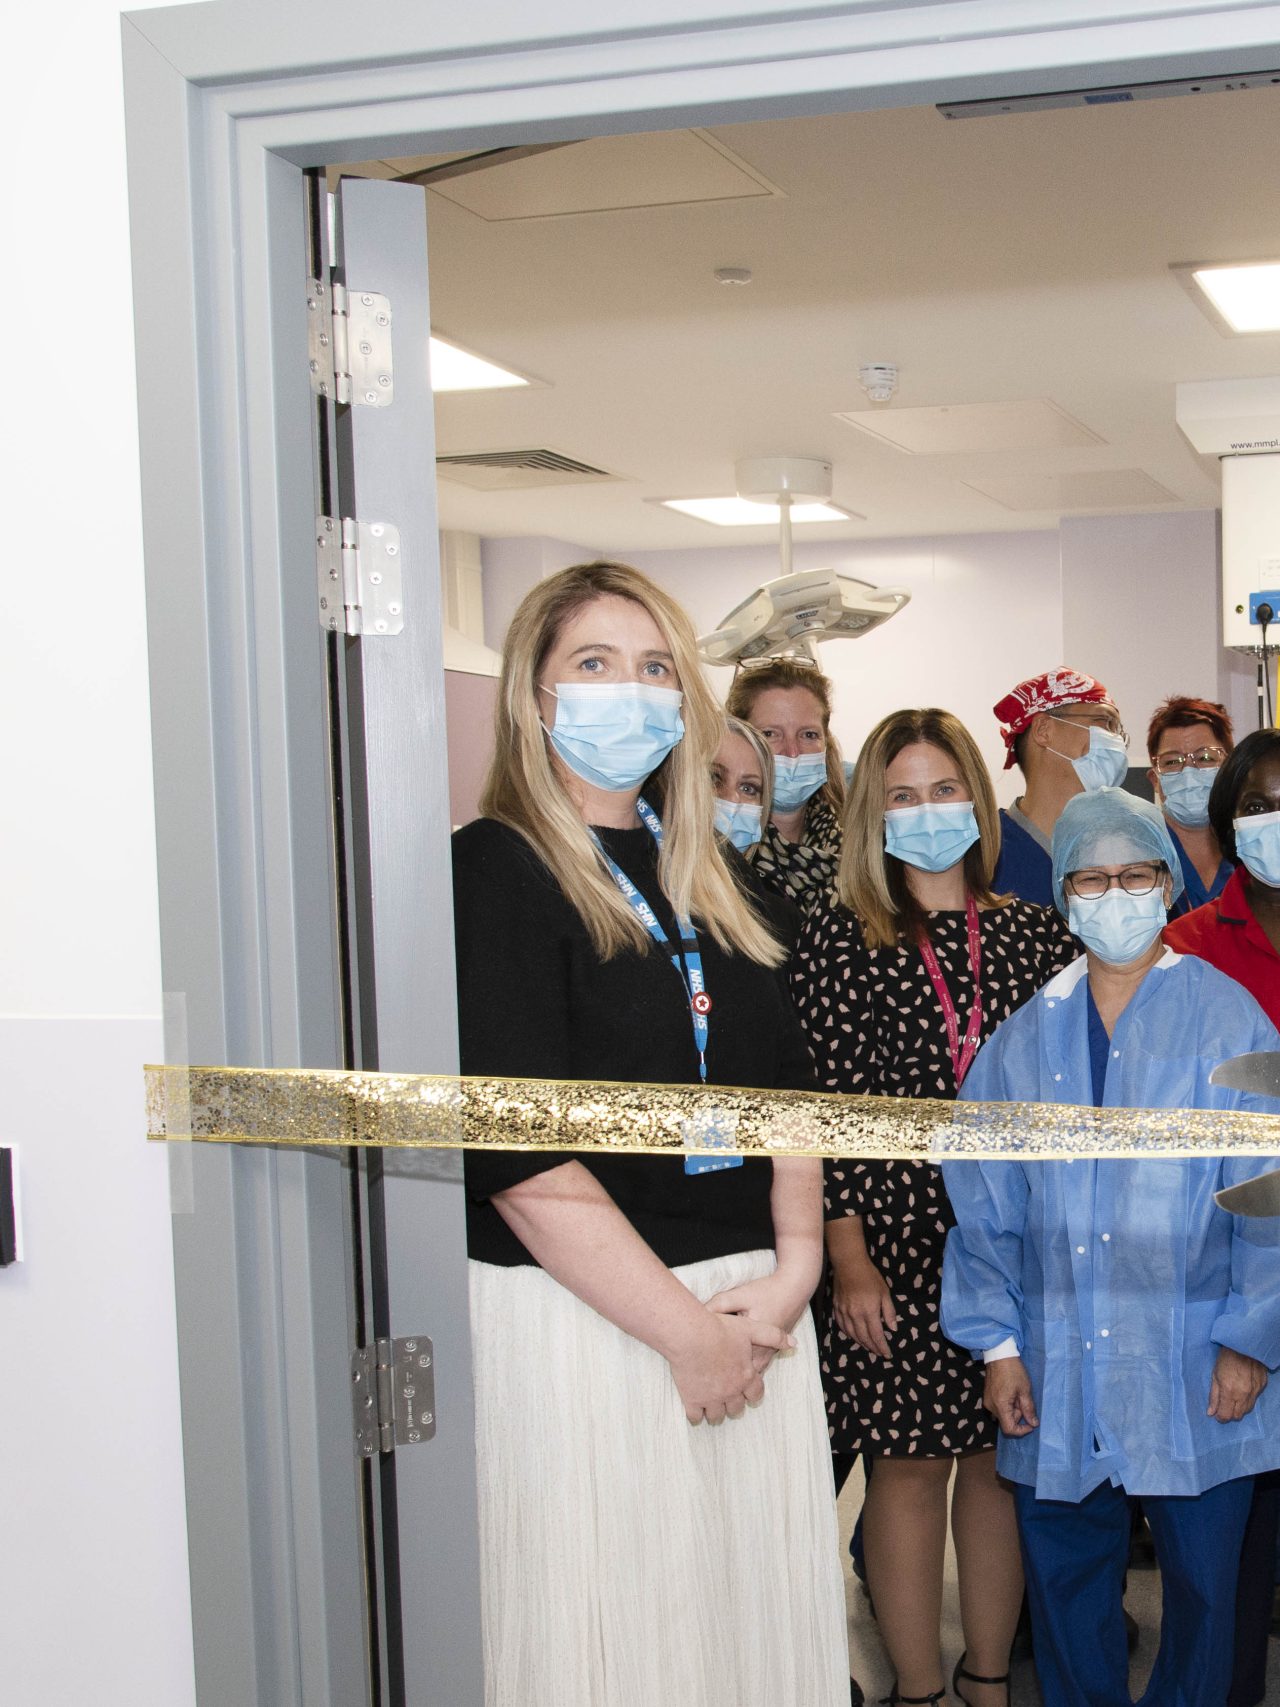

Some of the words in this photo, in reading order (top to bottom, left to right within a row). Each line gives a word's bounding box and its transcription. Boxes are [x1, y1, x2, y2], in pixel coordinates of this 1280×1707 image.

[645, 814, 662, 833] NHS
[616, 873, 637, 897] NHS
[635, 902, 657, 927] NHS
